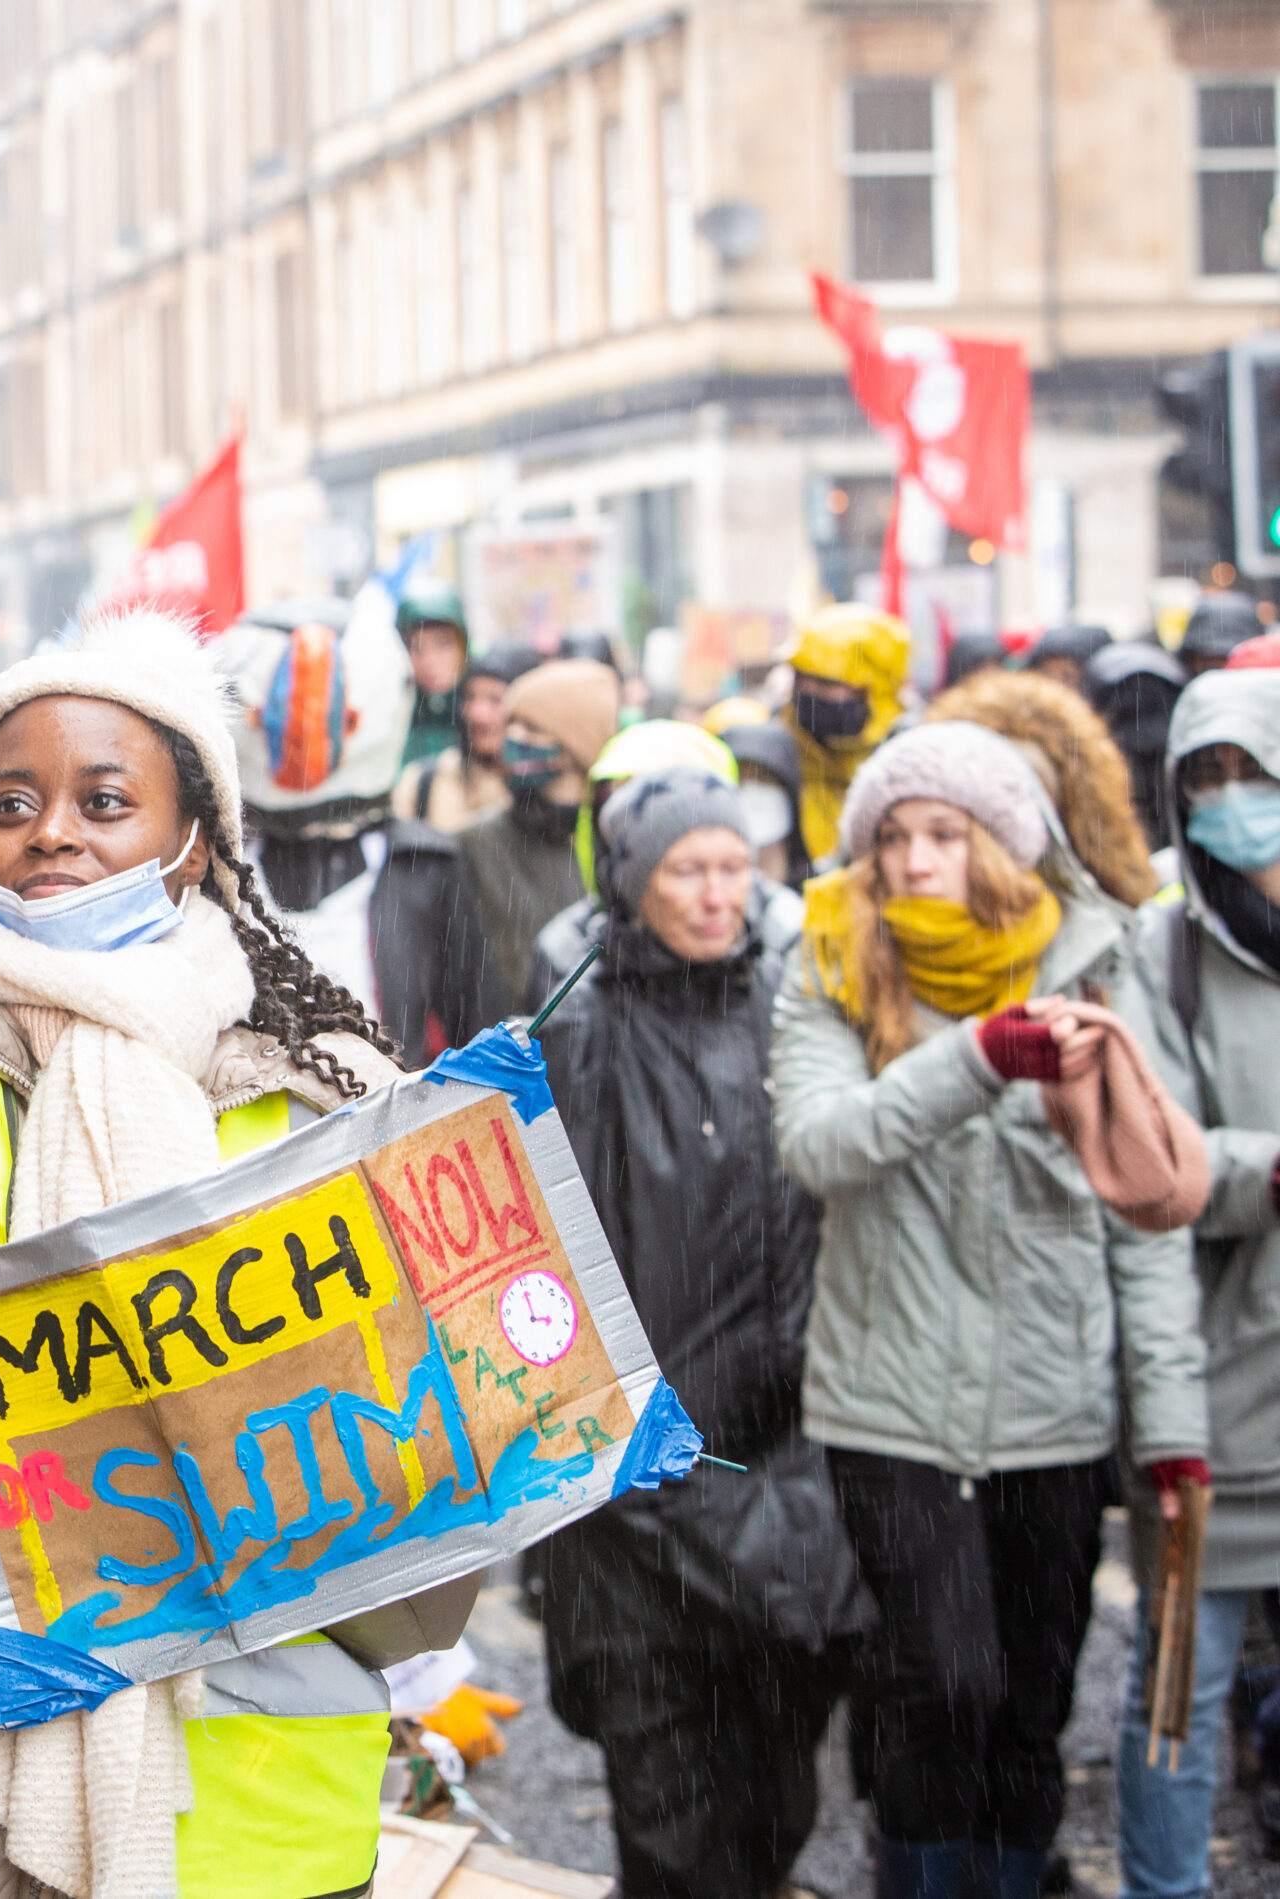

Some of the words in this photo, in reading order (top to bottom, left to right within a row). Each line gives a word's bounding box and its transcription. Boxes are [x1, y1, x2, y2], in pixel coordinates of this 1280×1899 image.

[372, 1117, 539, 1294] NOW
[548, 1287, 556, 1297] 2
[559, 1296, 569, 1309] 3
[502, 1307, 512, 1319] 10
[506, 1325, 516, 1336] 9
[438, 1323, 616, 1455] LATER
[93, 1345, 477, 1586] SWIM
